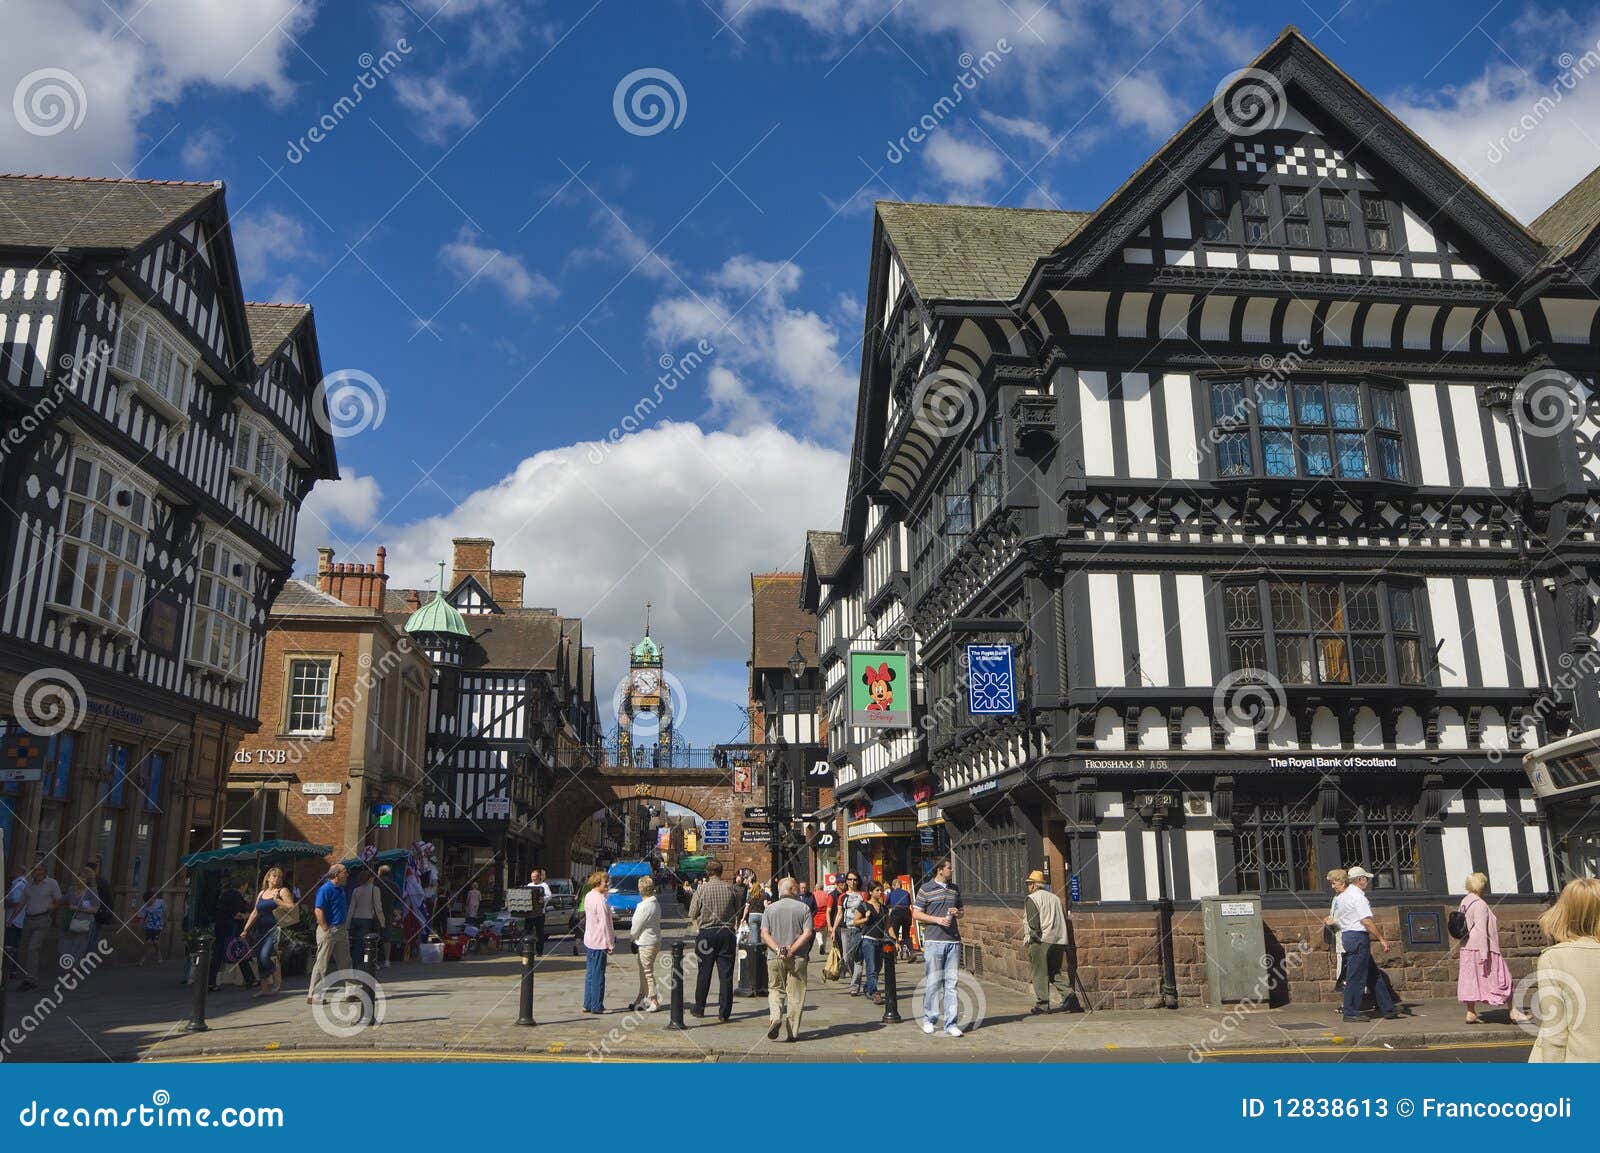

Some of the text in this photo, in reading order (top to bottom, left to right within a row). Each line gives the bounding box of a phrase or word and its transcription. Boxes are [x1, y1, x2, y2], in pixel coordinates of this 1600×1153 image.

[256, 749, 286, 763] TSB
[809, 761, 830, 775] JD
[1085, 759, 1134, 769] FRODSHAM
[1268, 757, 1397, 769] The Royal Bank of Scotland
[818, 834, 833, 845] JD
